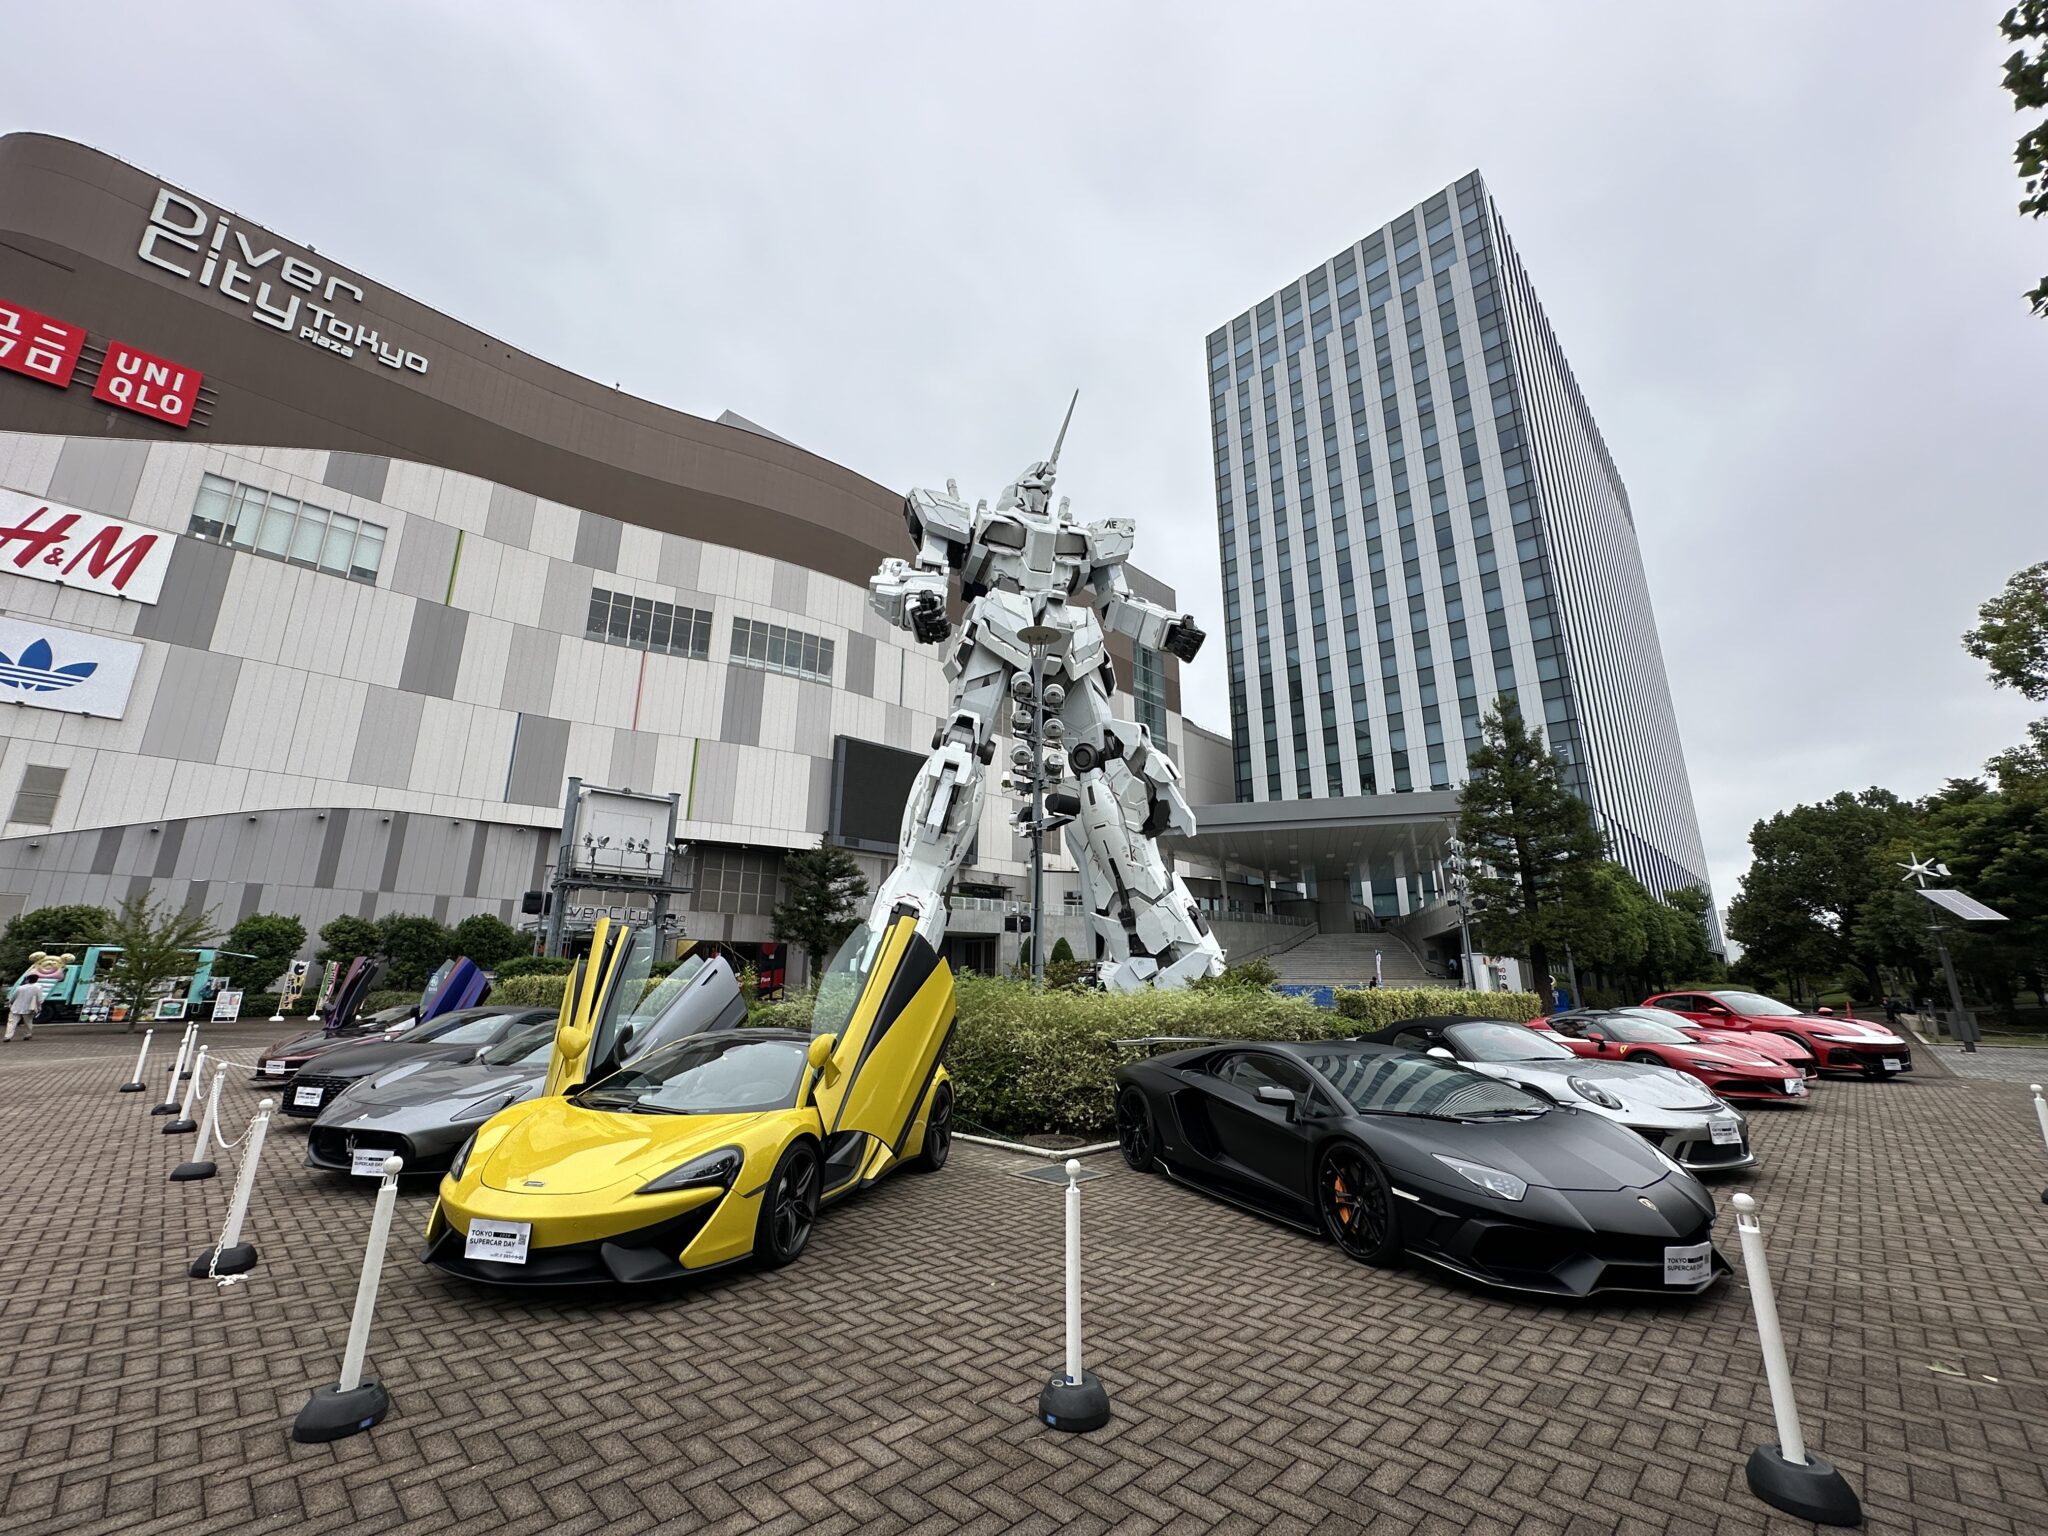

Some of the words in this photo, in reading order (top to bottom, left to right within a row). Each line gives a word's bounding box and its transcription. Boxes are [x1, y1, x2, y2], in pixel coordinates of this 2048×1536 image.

[150, 188, 364, 302] Diver
[138, 225, 300, 332] City
[300, 325, 354, 358] Plaza
[116, 351, 185, 392] UNI
[108, 376, 183, 415] QLO
[0, 506, 158, 591] H&M
[469, 1238, 502, 1247] SUPERCAR
[503, 1240, 516, 1248] DAY
[471, 1229, 493, 1237] TOKYO
